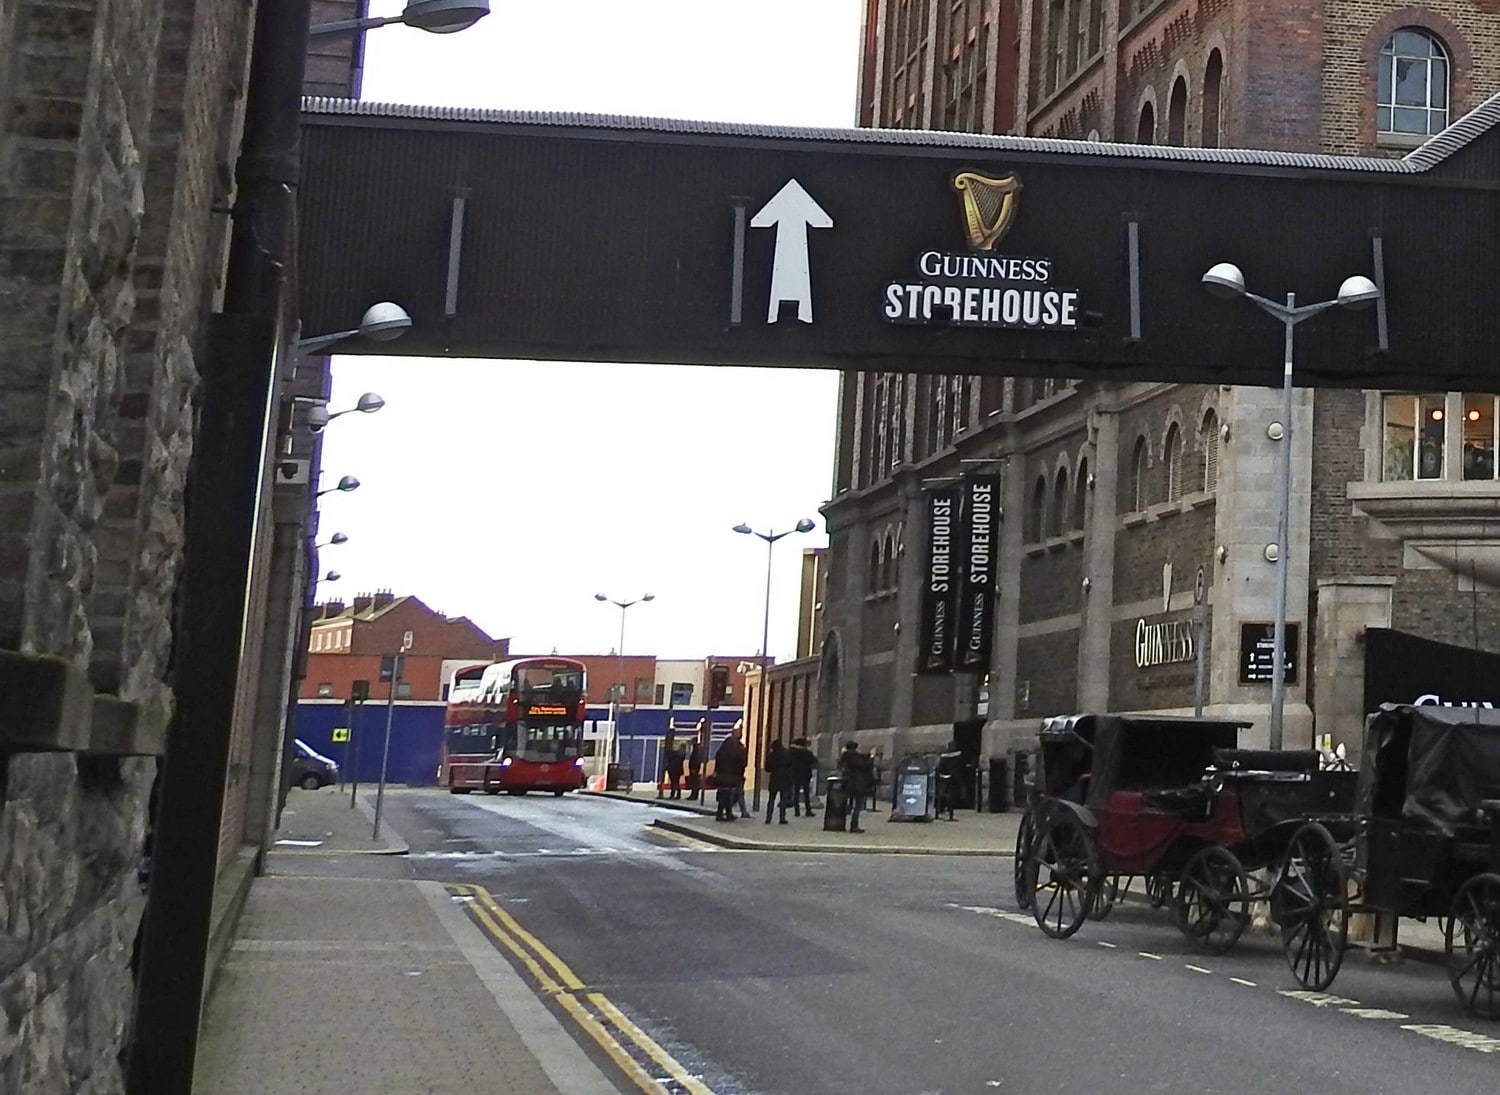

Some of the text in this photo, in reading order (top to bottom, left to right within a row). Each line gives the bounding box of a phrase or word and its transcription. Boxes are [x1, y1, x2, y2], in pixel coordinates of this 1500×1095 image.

[920, 251, 1050, 282] GUINNESS
[885, 283, 1078, 326] STOREHOUSE
[930, 498, 951, 655] GUINNESS STOREHOUSE
[968, 483, 992, 651] GUINNESS STOREHOUSE
[1135, 617, 1194, 668] GUINNESS
